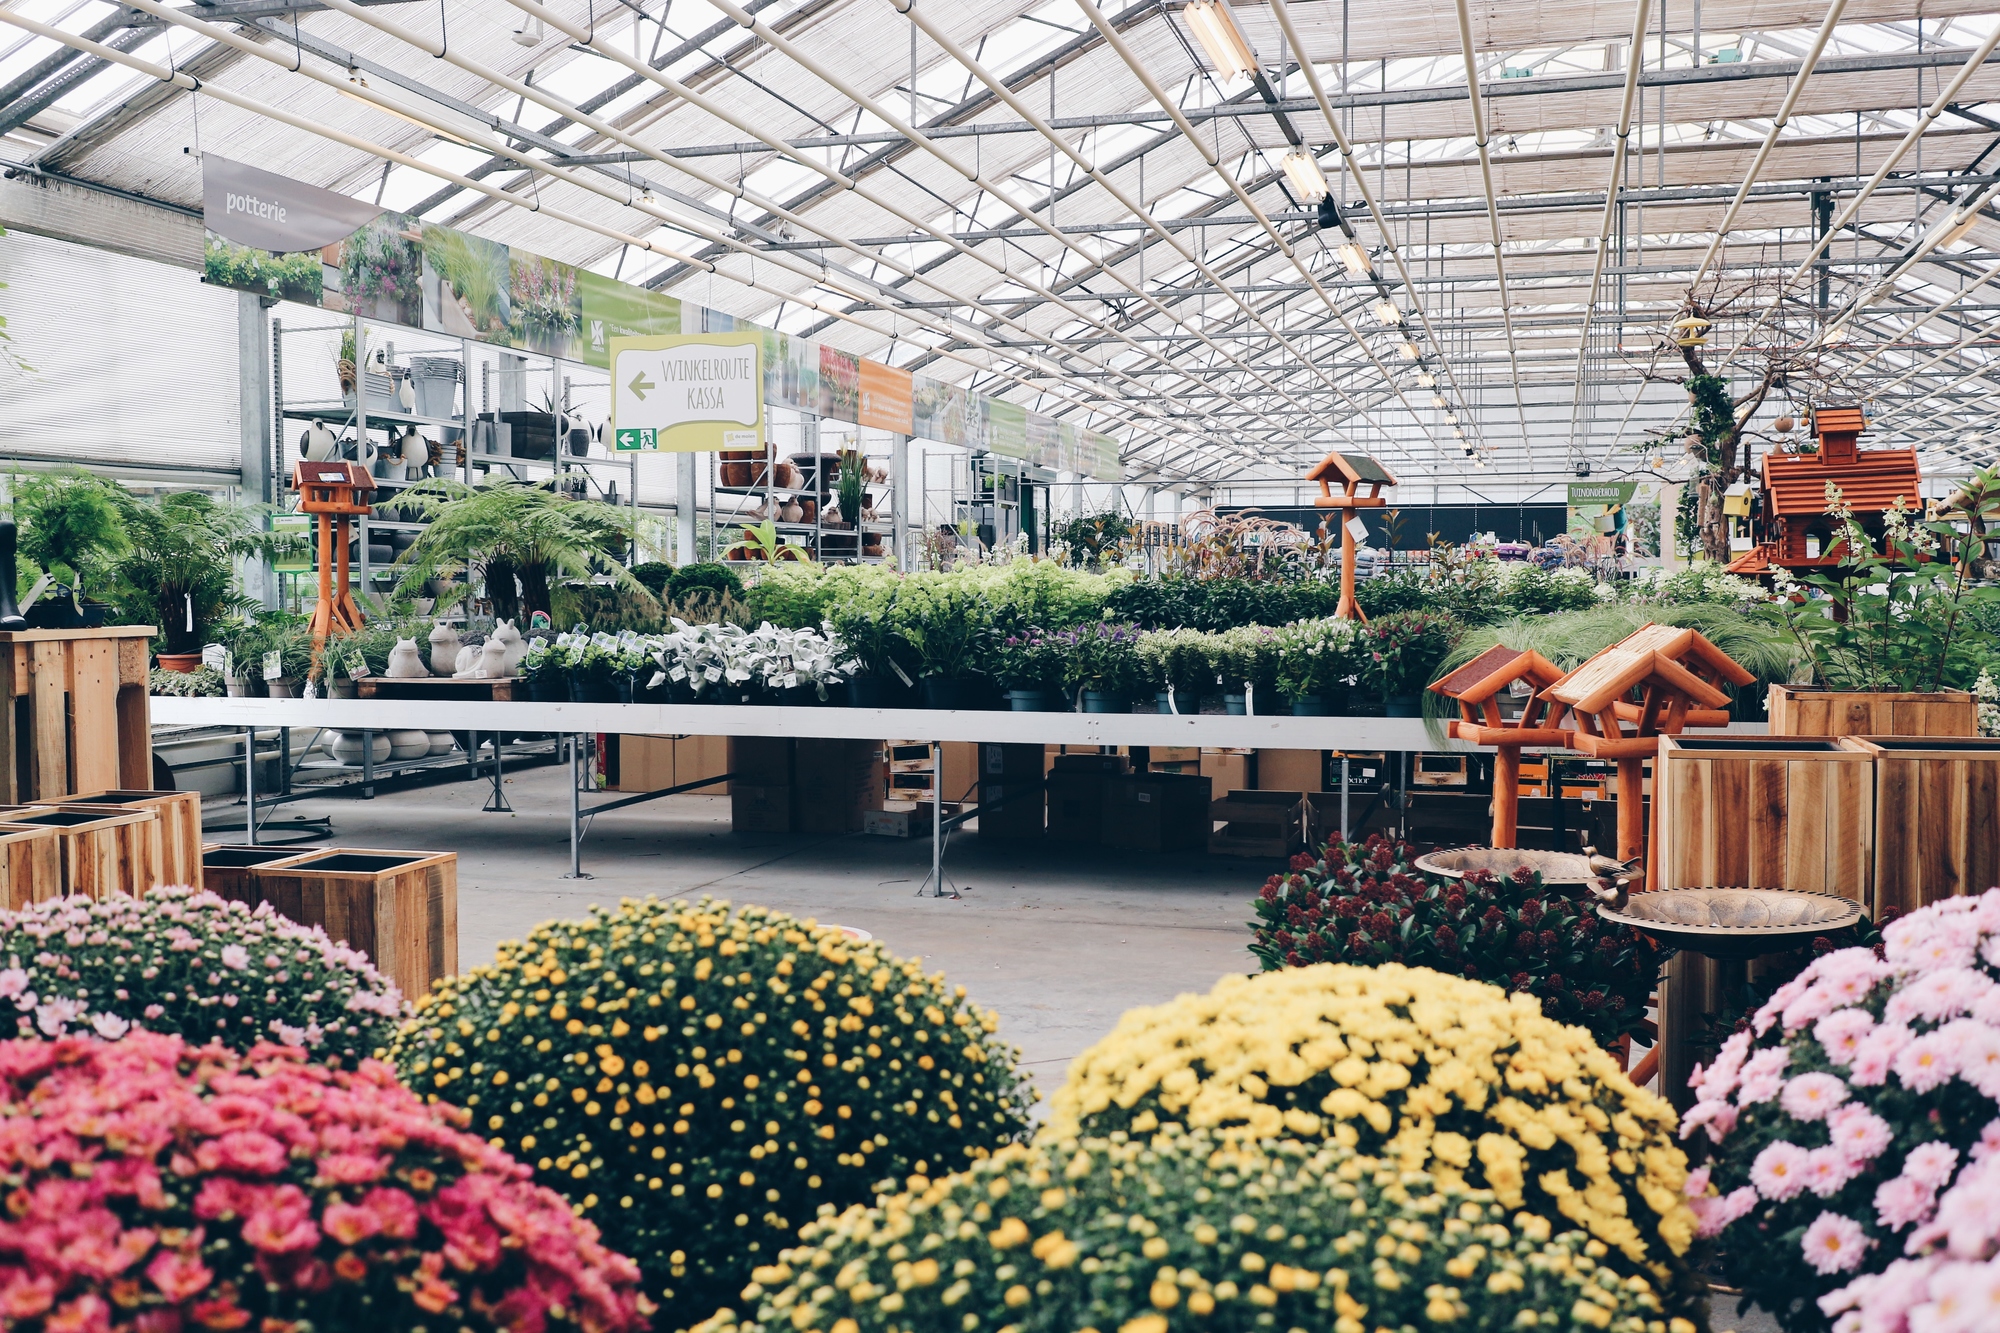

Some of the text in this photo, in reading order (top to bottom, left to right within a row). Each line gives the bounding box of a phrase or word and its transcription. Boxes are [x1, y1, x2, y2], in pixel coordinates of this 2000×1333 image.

[226, 192, 287, 224] potterie
[661, 358, 750, 382] WINKELROUTE
[687, 386, 725, 410] KASSA
[1571, 487, 1620, 498] TUINONDERHOUD
